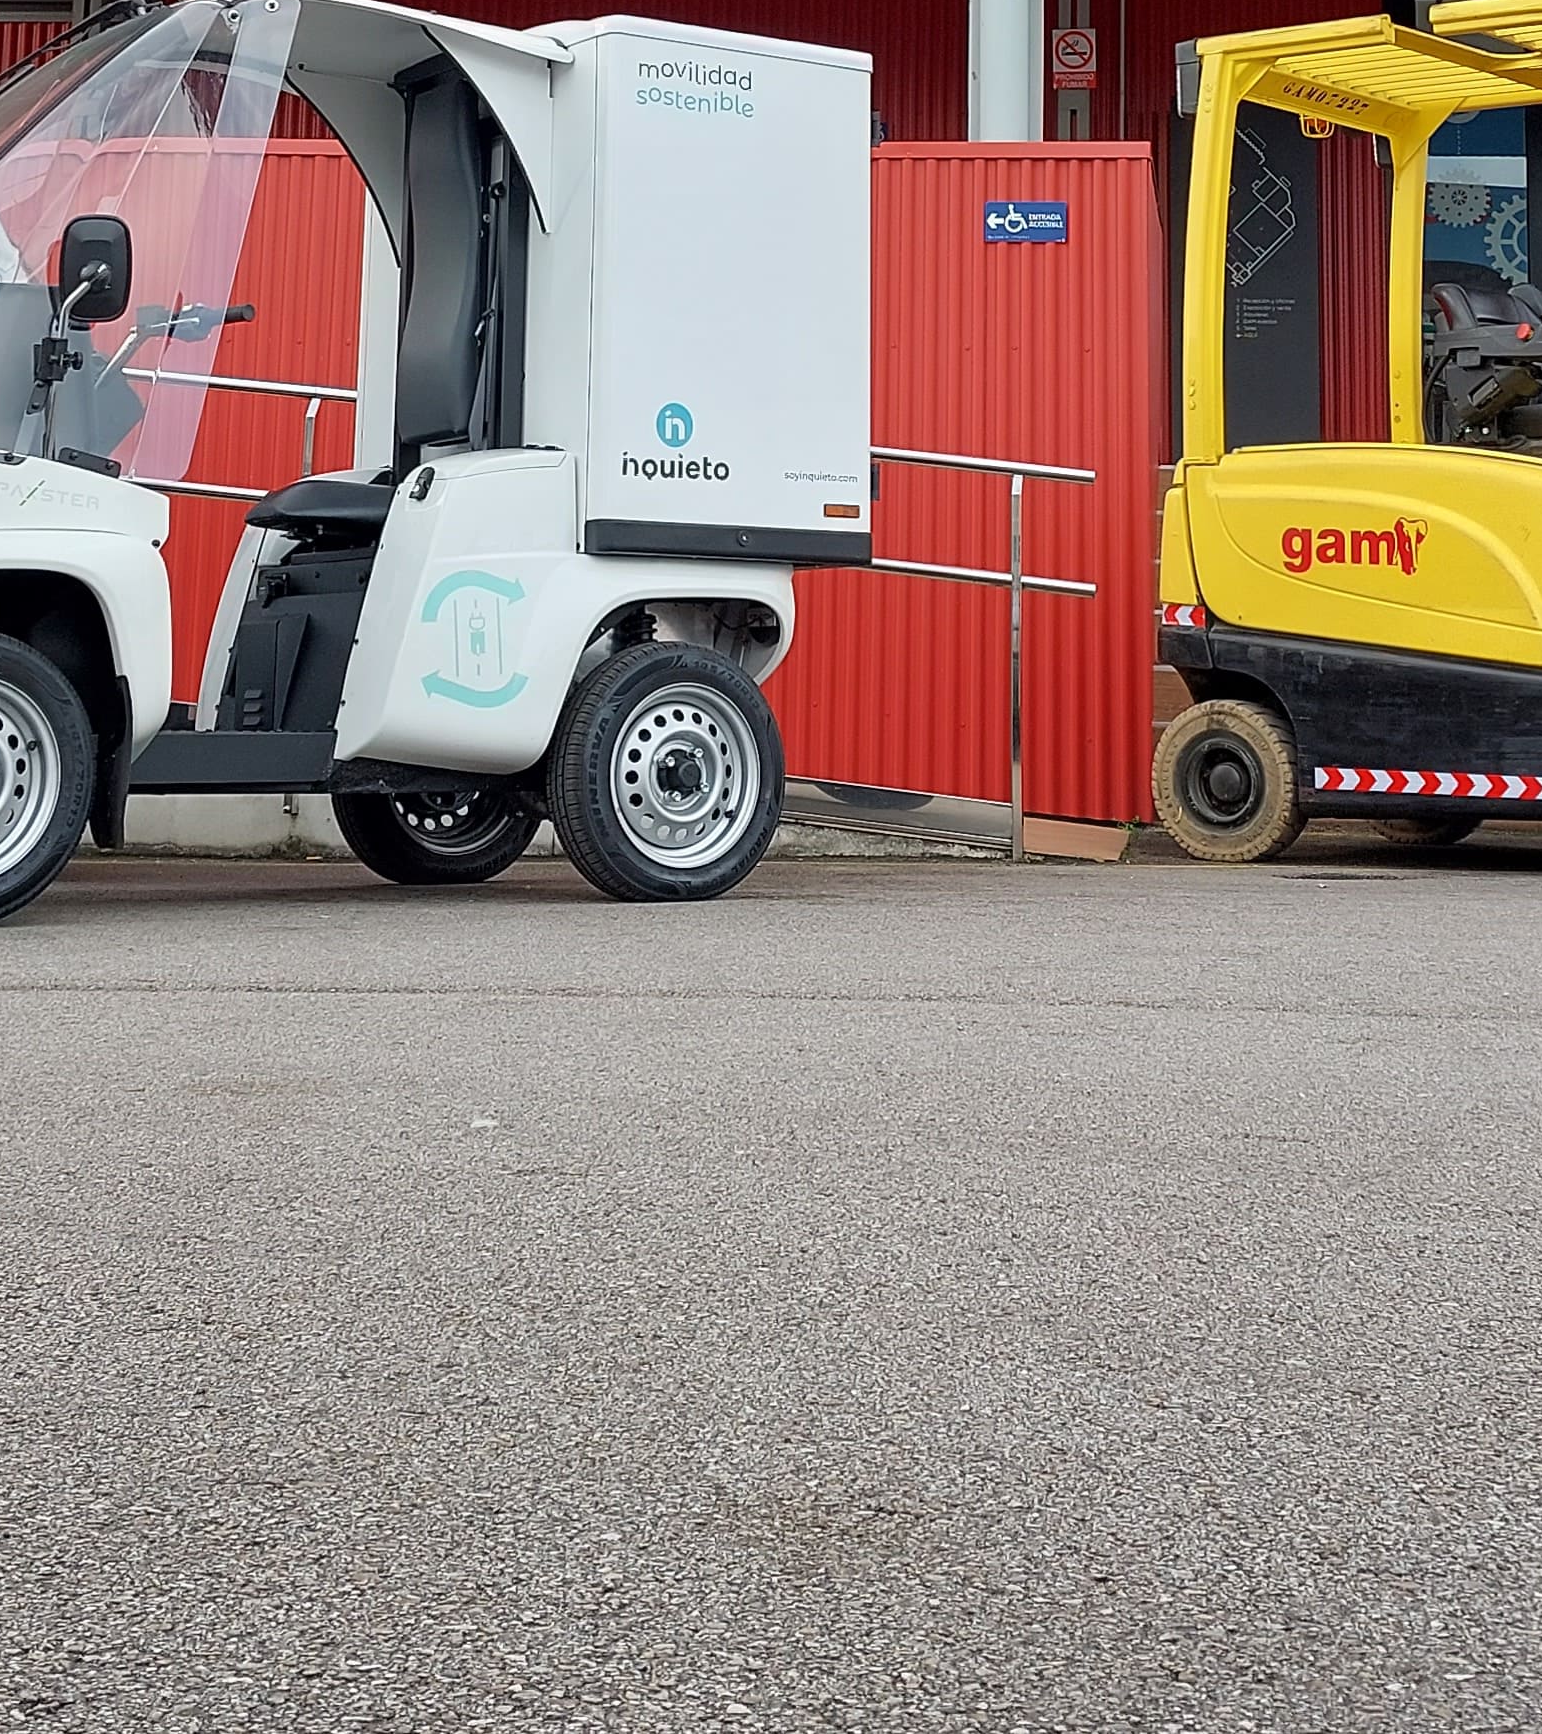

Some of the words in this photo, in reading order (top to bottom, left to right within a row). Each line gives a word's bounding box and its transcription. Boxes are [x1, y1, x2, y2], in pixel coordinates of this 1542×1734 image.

[639, 61, 752, 91] movilidad
[636, 87, 754, 118] sostenible
[621, 451, 730, 481] inquieto
[784, 470, 858, 483] soyinquieto.com
[1281, 527, 1396, 574] gam
